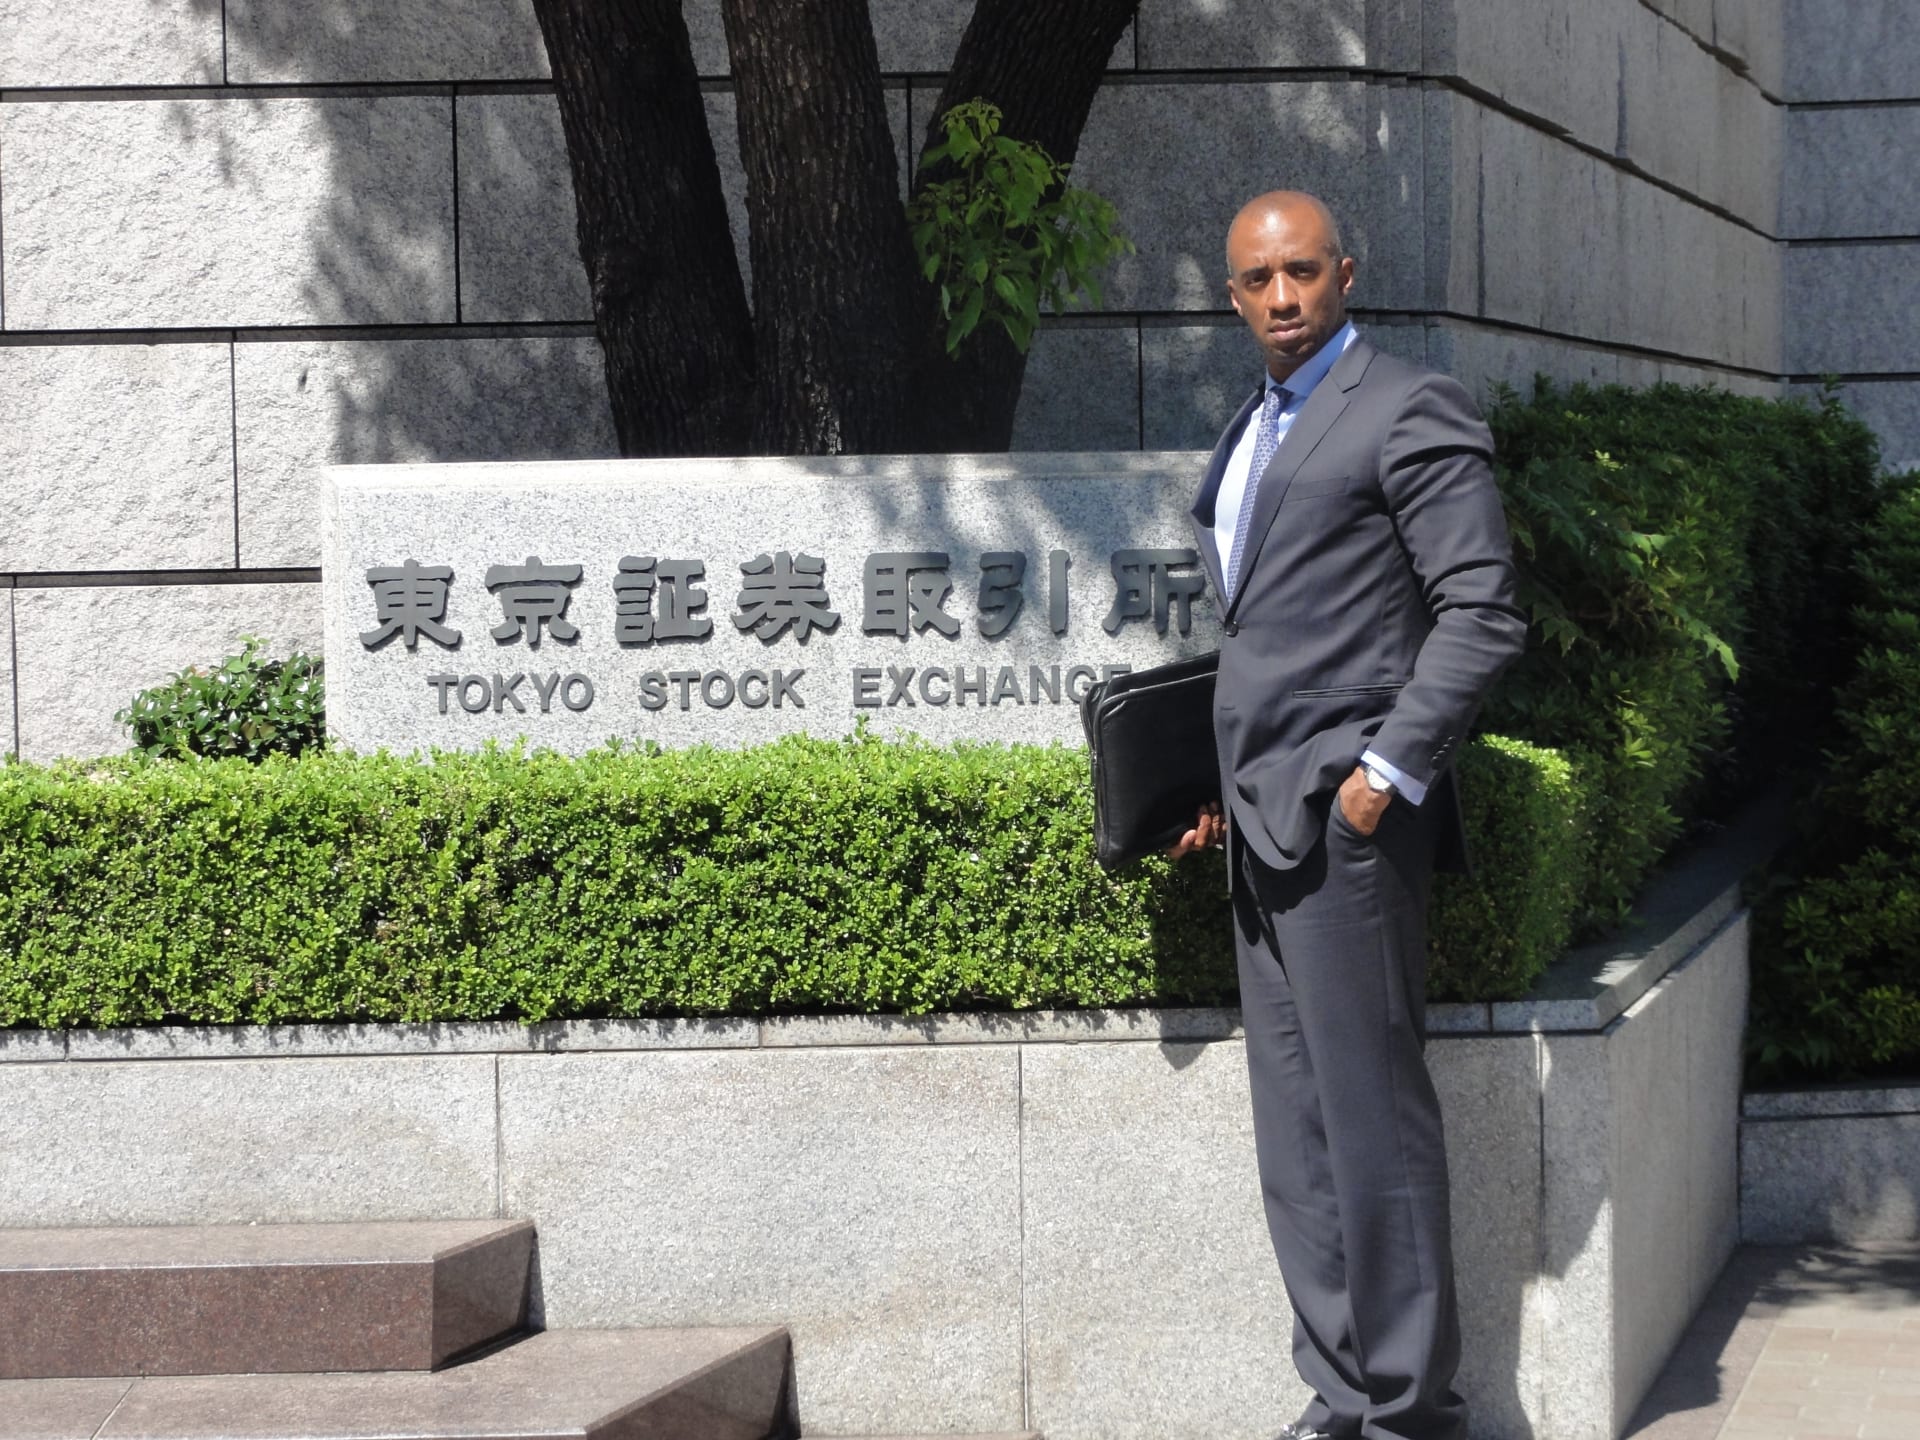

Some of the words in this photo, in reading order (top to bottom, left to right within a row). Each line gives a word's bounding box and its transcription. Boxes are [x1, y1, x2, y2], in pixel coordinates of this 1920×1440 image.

[359, 549, 1205, 650] 東京証券取引所
[427, 672, 594, 713] TOKYO
[638, 669, 805, 711] STOCK
